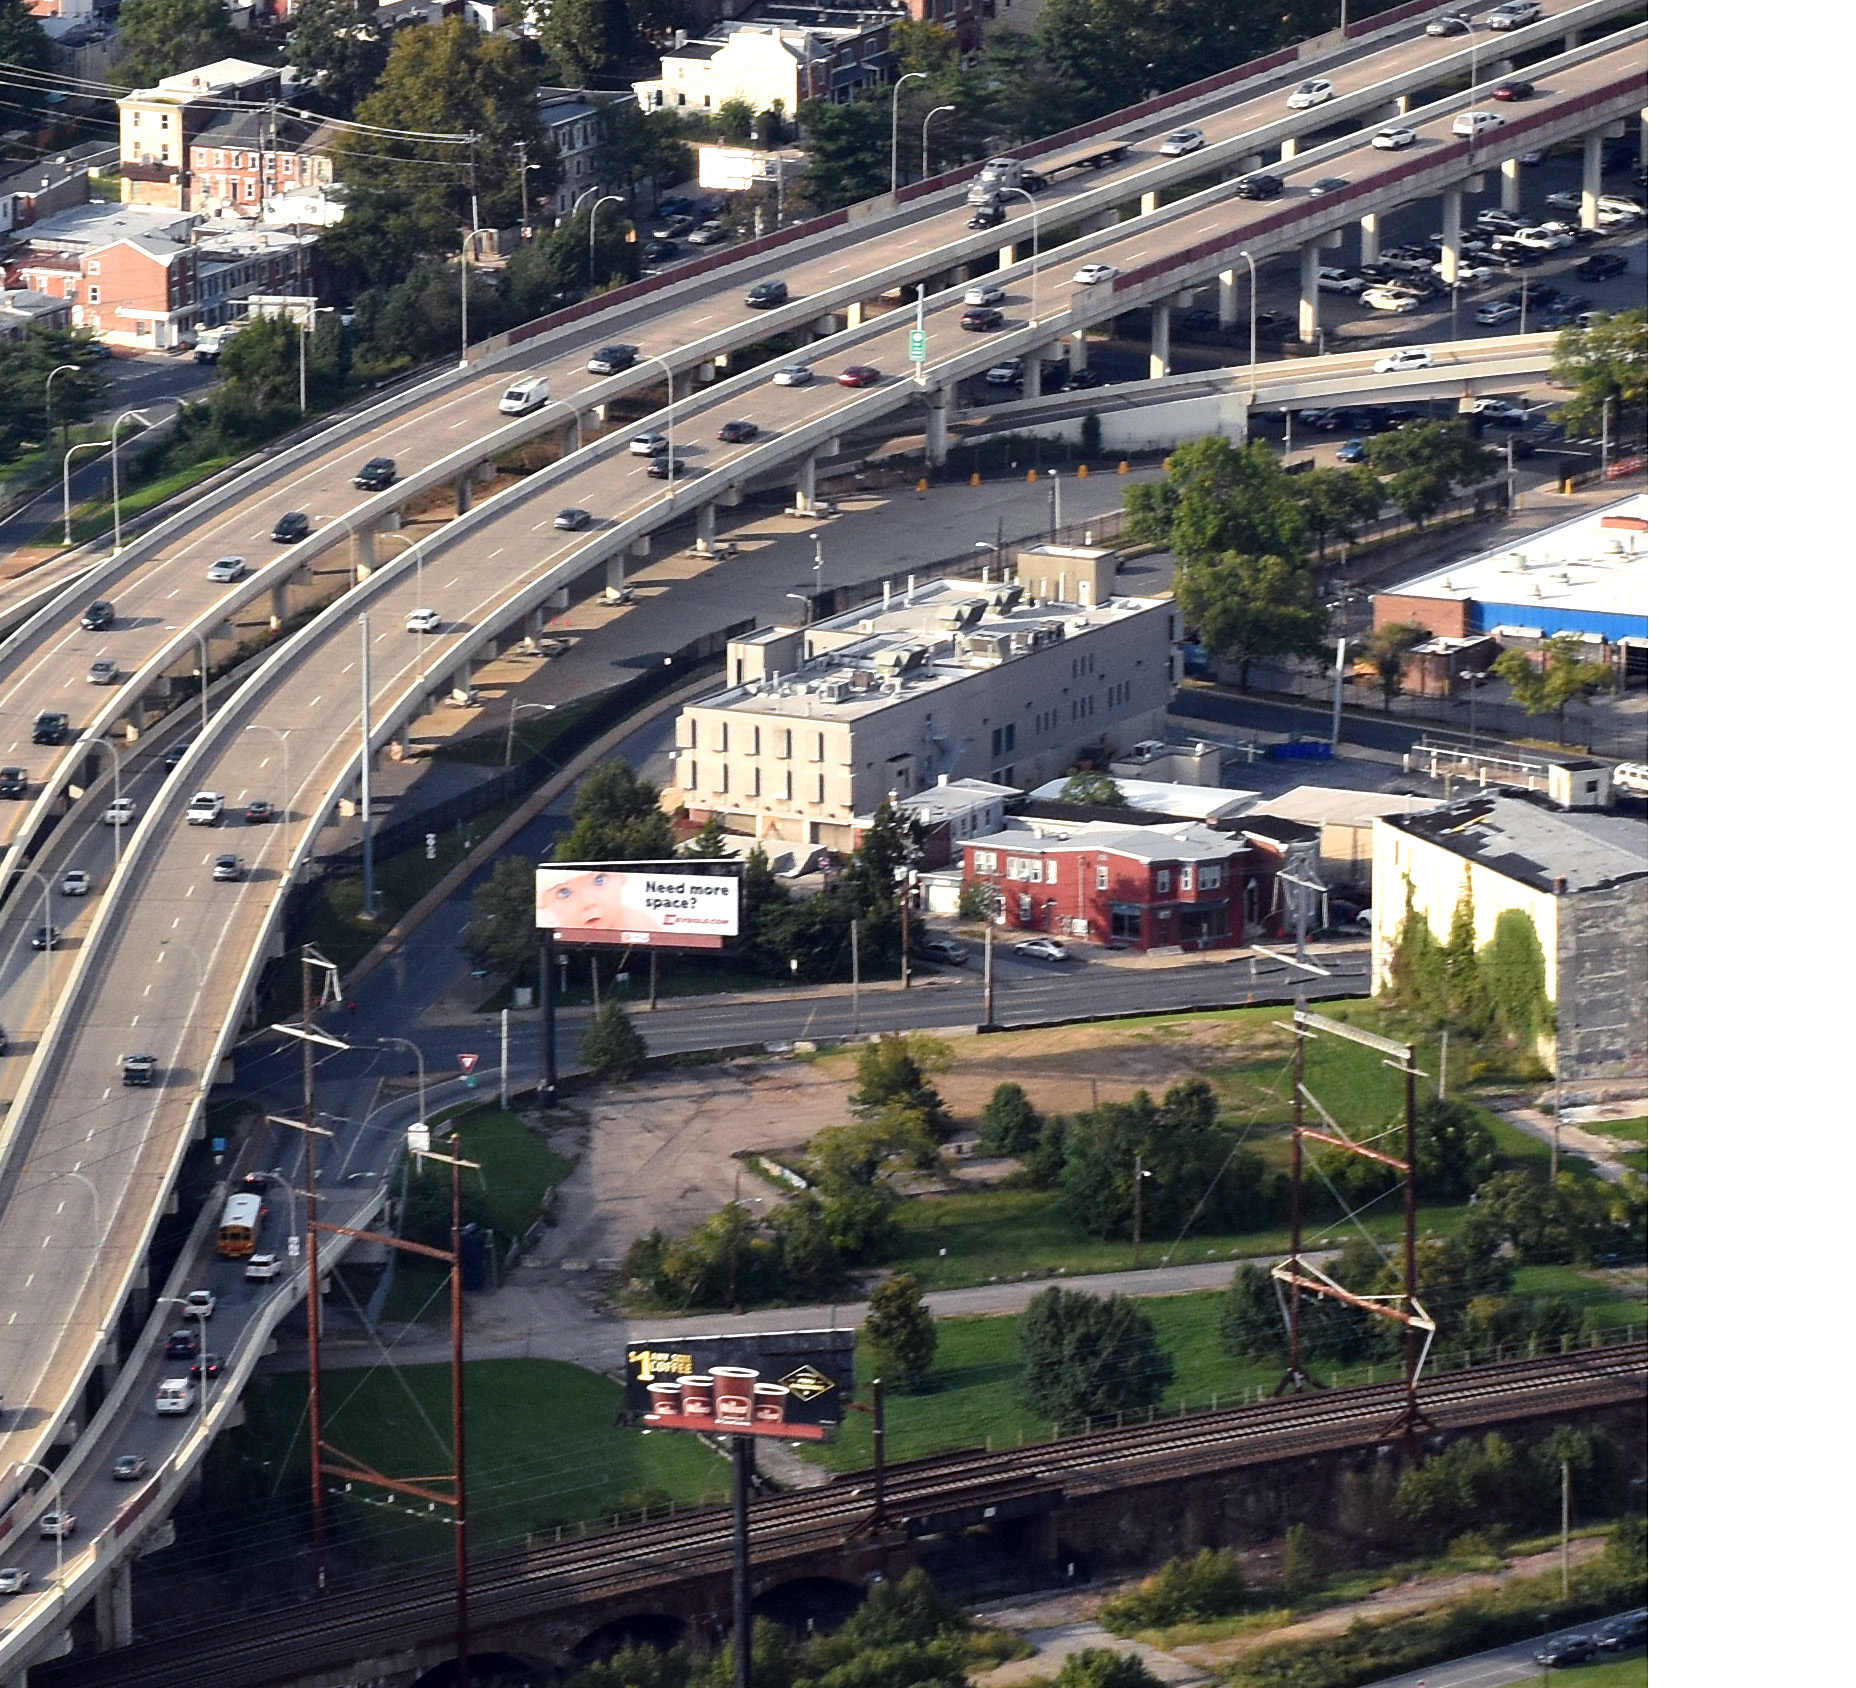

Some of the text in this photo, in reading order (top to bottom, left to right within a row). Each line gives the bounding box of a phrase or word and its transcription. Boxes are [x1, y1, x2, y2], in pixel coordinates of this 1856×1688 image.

[646, 881, 729, 896] Need more
[646, 897, 697, 910] space?
[628, 1350, 655, 1381] $1
[650, 1361, 694, 1375] COFFEE
